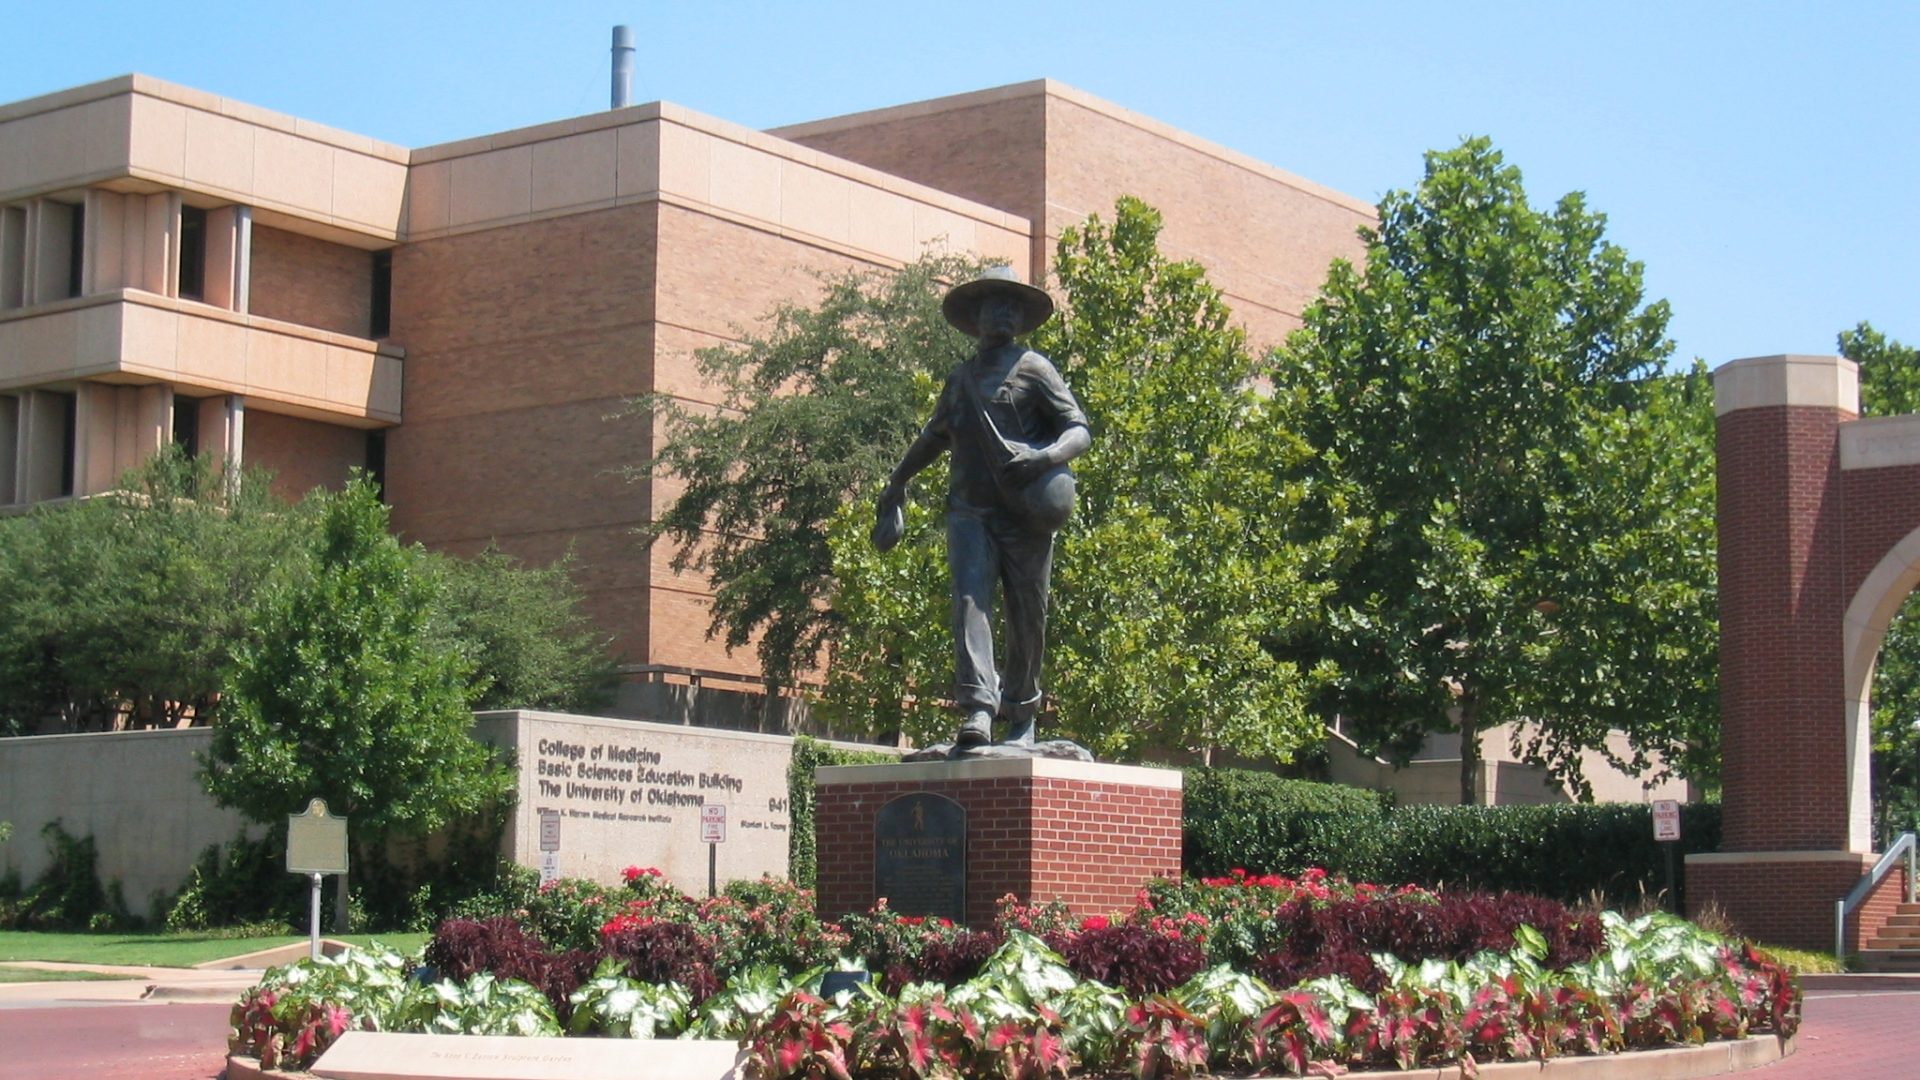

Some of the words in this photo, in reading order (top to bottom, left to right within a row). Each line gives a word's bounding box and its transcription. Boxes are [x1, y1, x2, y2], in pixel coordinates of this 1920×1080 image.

[538, 738, 586, 761] College
[590, 744, 603, 760] of
[607, 745, 661, 765] Medicine
[537, 758, 573, 778] Basic
[577, 762, 633, 783] Sciences
[637, 765, 694, 787] Education
[700, 772, 743, 793] Building
[538, 779, 562, 798] The
[566, 781, 626, 805] University
[630, 787, 643, 803] of
[647, 788, 705, 808] Oklahoma
[702, 815, 725, 823] PARKING
[708, 807, 719, 816] NO
[889, 847, 950, 858] OKLAHOMA
